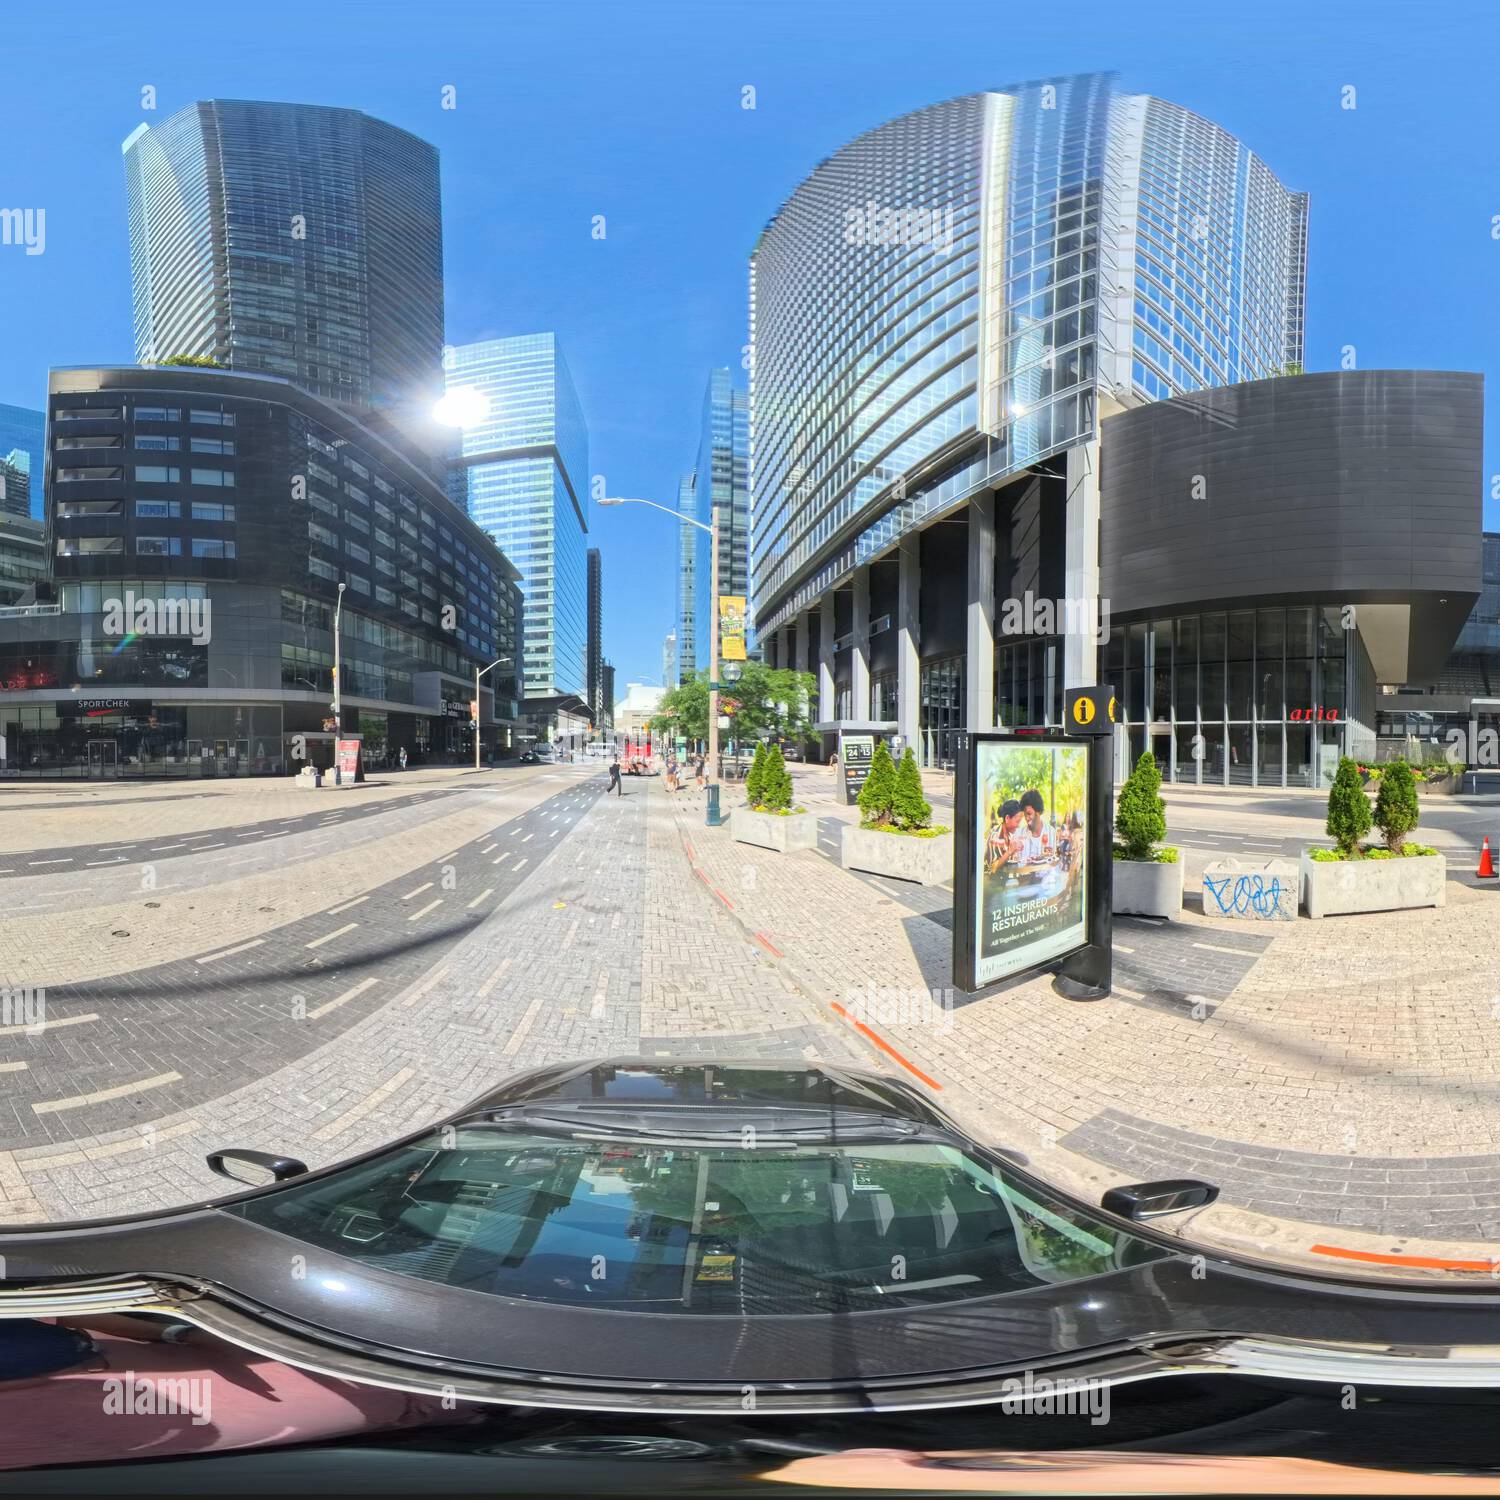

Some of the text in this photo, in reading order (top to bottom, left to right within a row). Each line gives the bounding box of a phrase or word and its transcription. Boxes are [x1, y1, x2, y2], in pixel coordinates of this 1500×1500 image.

[78, 699, 129, 708] SPORTCHEK
[1290, 705, 1338, 721] aria
[992, 897, 1048, 920] 12 INSPIRED
[992, 904, 1058, 933] RESTAURANTS
